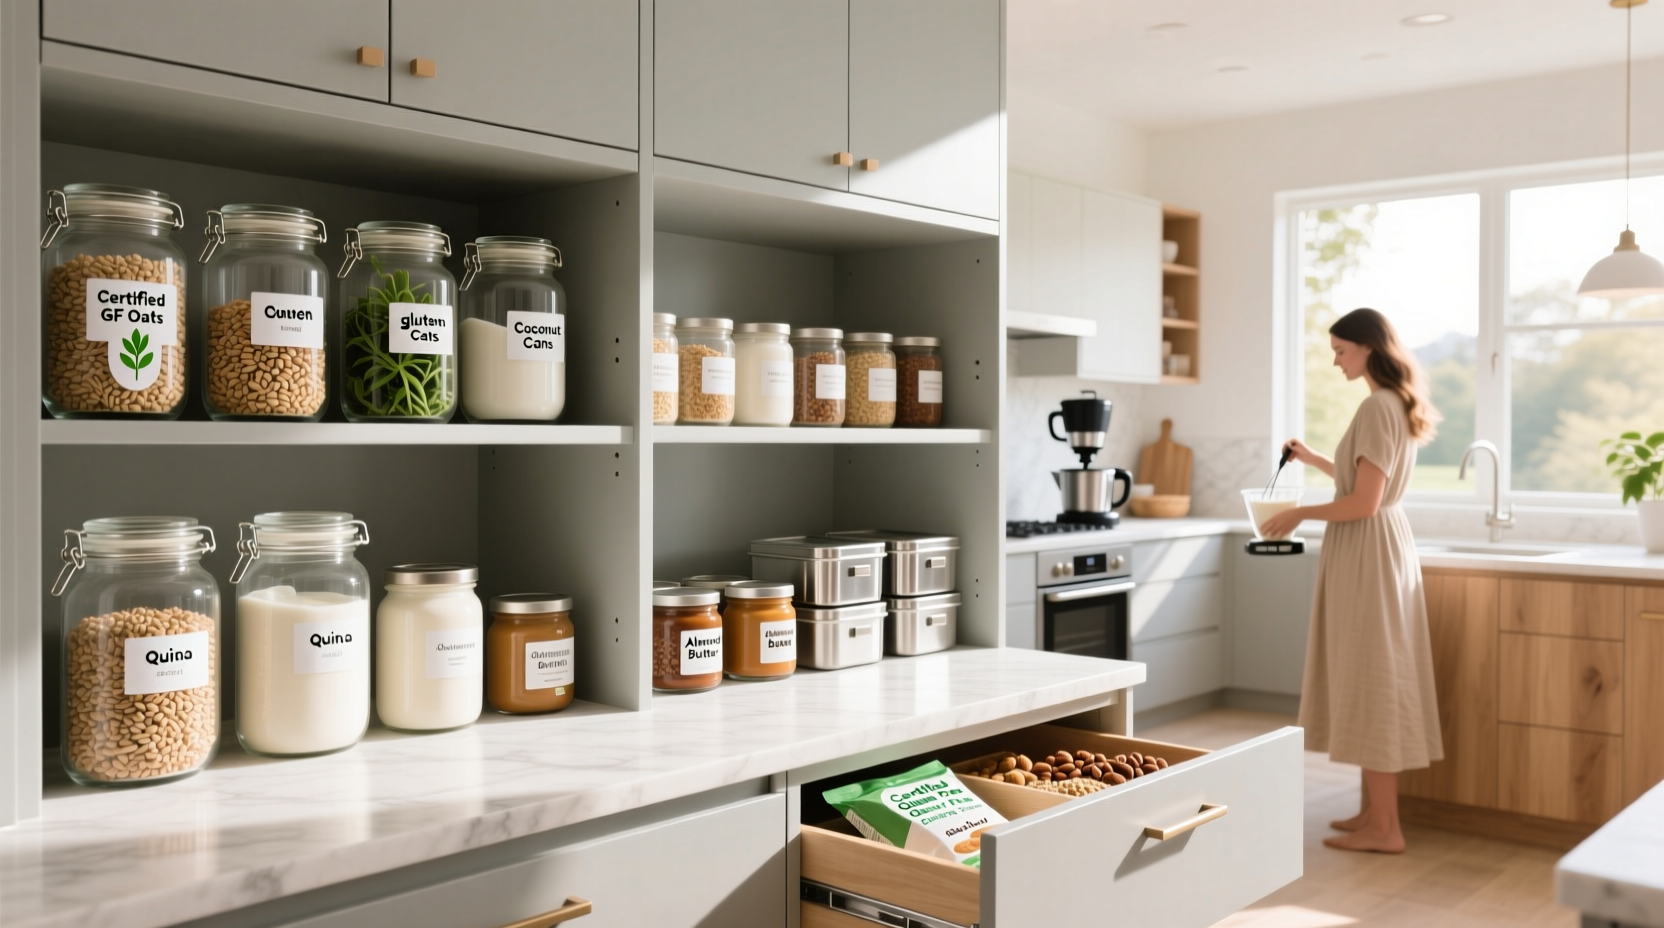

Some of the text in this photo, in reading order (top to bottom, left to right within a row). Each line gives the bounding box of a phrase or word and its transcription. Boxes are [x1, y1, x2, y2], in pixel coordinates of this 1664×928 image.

[97, 289, 166, 307] Certified
[100, 308, 164, 325] GF Oats
[514, 321, 562, 336] Coconut
[523, 336, 554, 350] Cans
